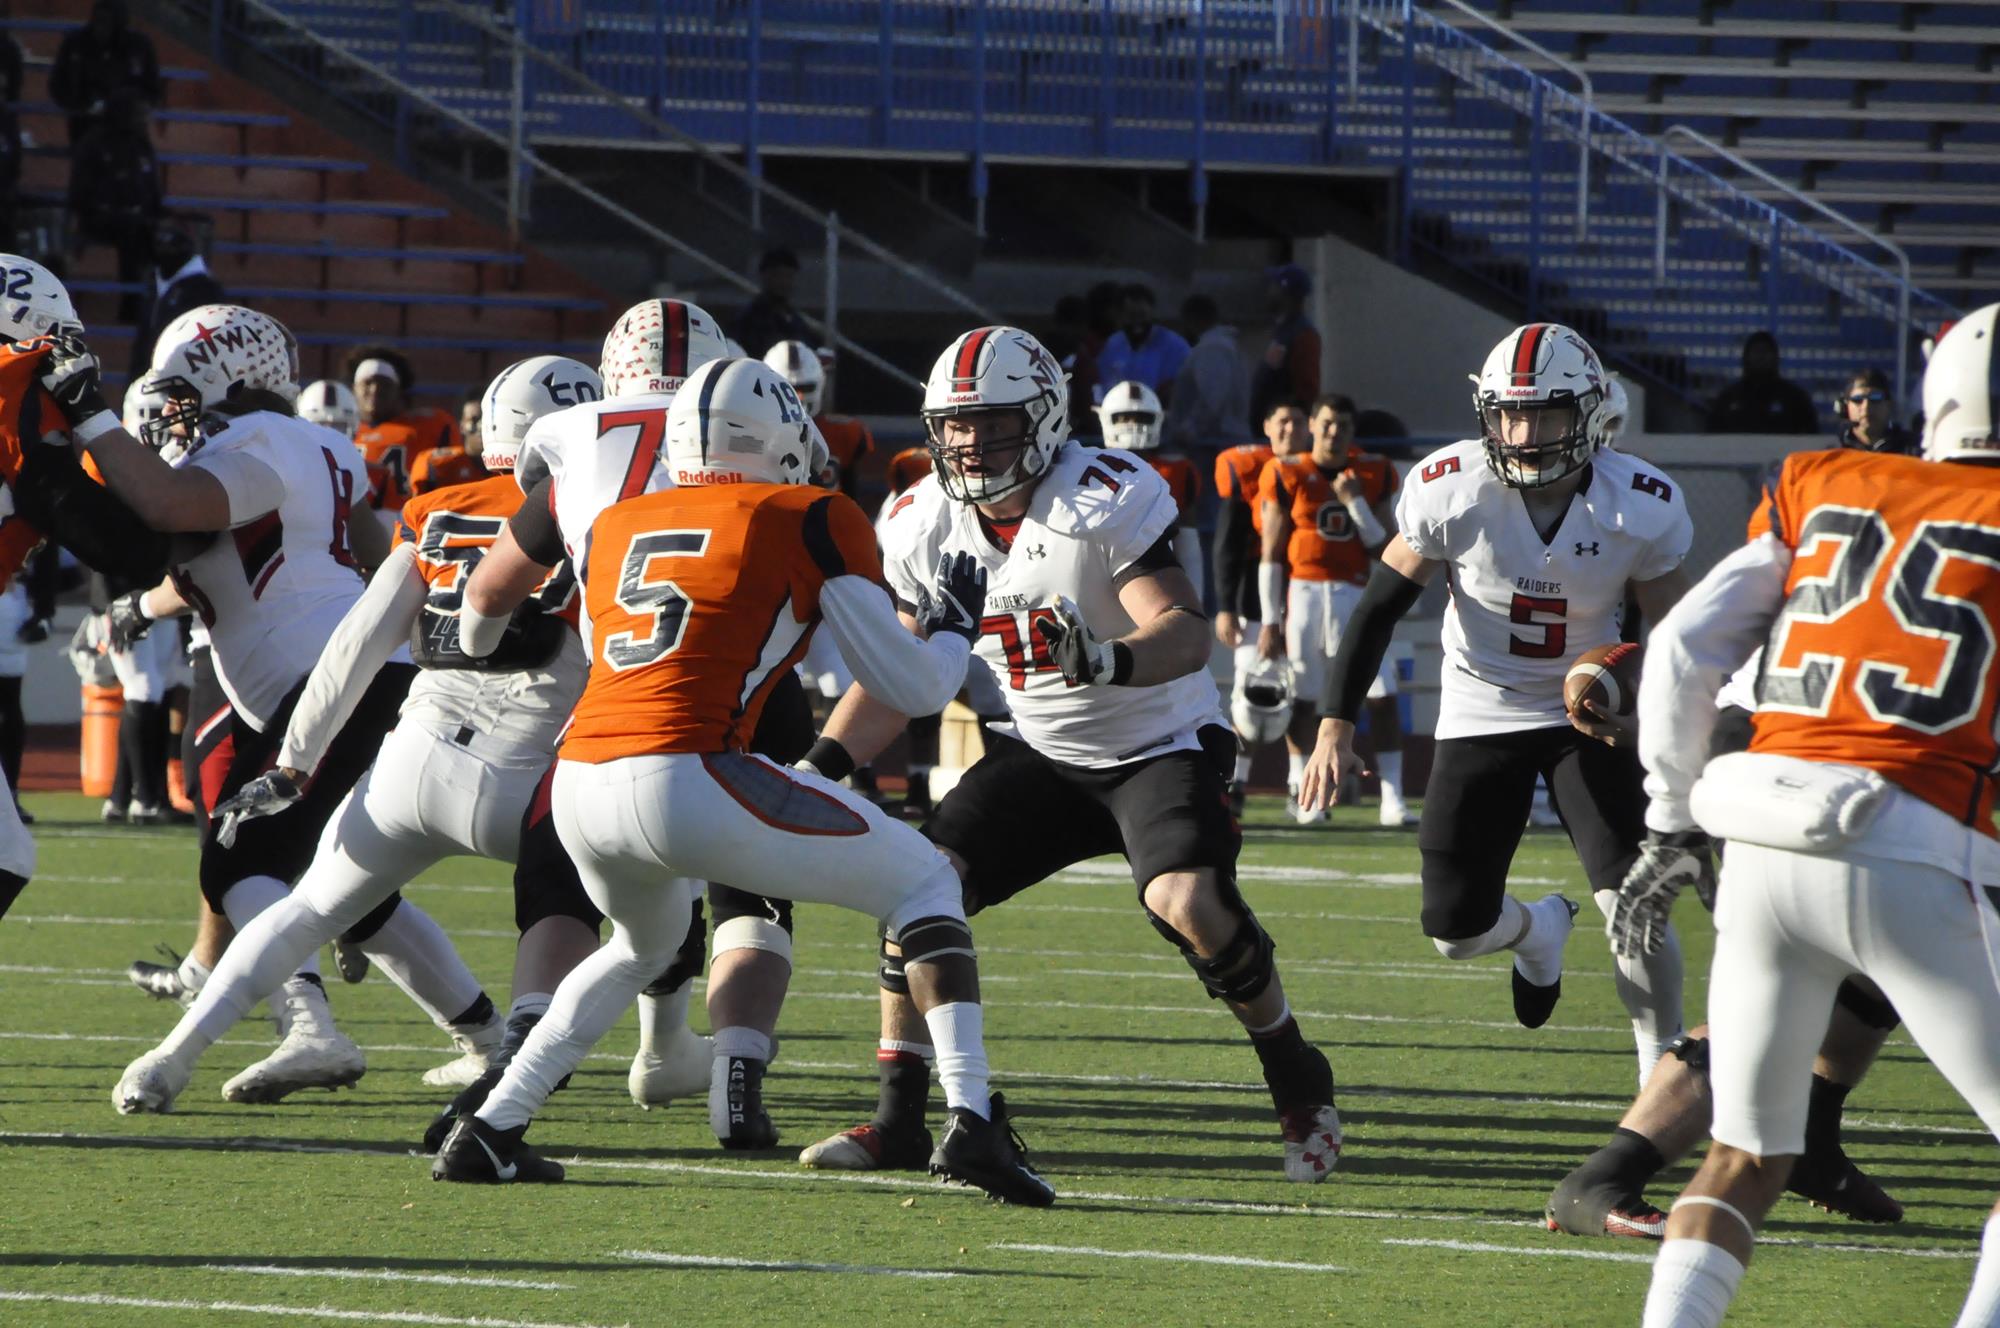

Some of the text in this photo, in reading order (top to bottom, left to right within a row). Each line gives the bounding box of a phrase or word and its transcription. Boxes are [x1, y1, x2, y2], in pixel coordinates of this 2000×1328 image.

[649, 378, 686, 391] Ridd
[947, 394, 980, 403] Riddell
[1506, 389, 1539, 397] Riddell
[769, 381, 805, 424] 19
[677, 470, 743, 485] Riddell
[1077, 452, 1139, 495] 74
[1421, 455, 1461, 484] 5
[1631, 471, 1673, 503] 5
[1516, 576, 1562, 594] RAIDERS
[603, 528, 713, 673] 5
[989, 593, 1029, 610] RAIDERS
[1508, 592, 1568, 659] 5
[1754, 502, 2000, 735] 25
